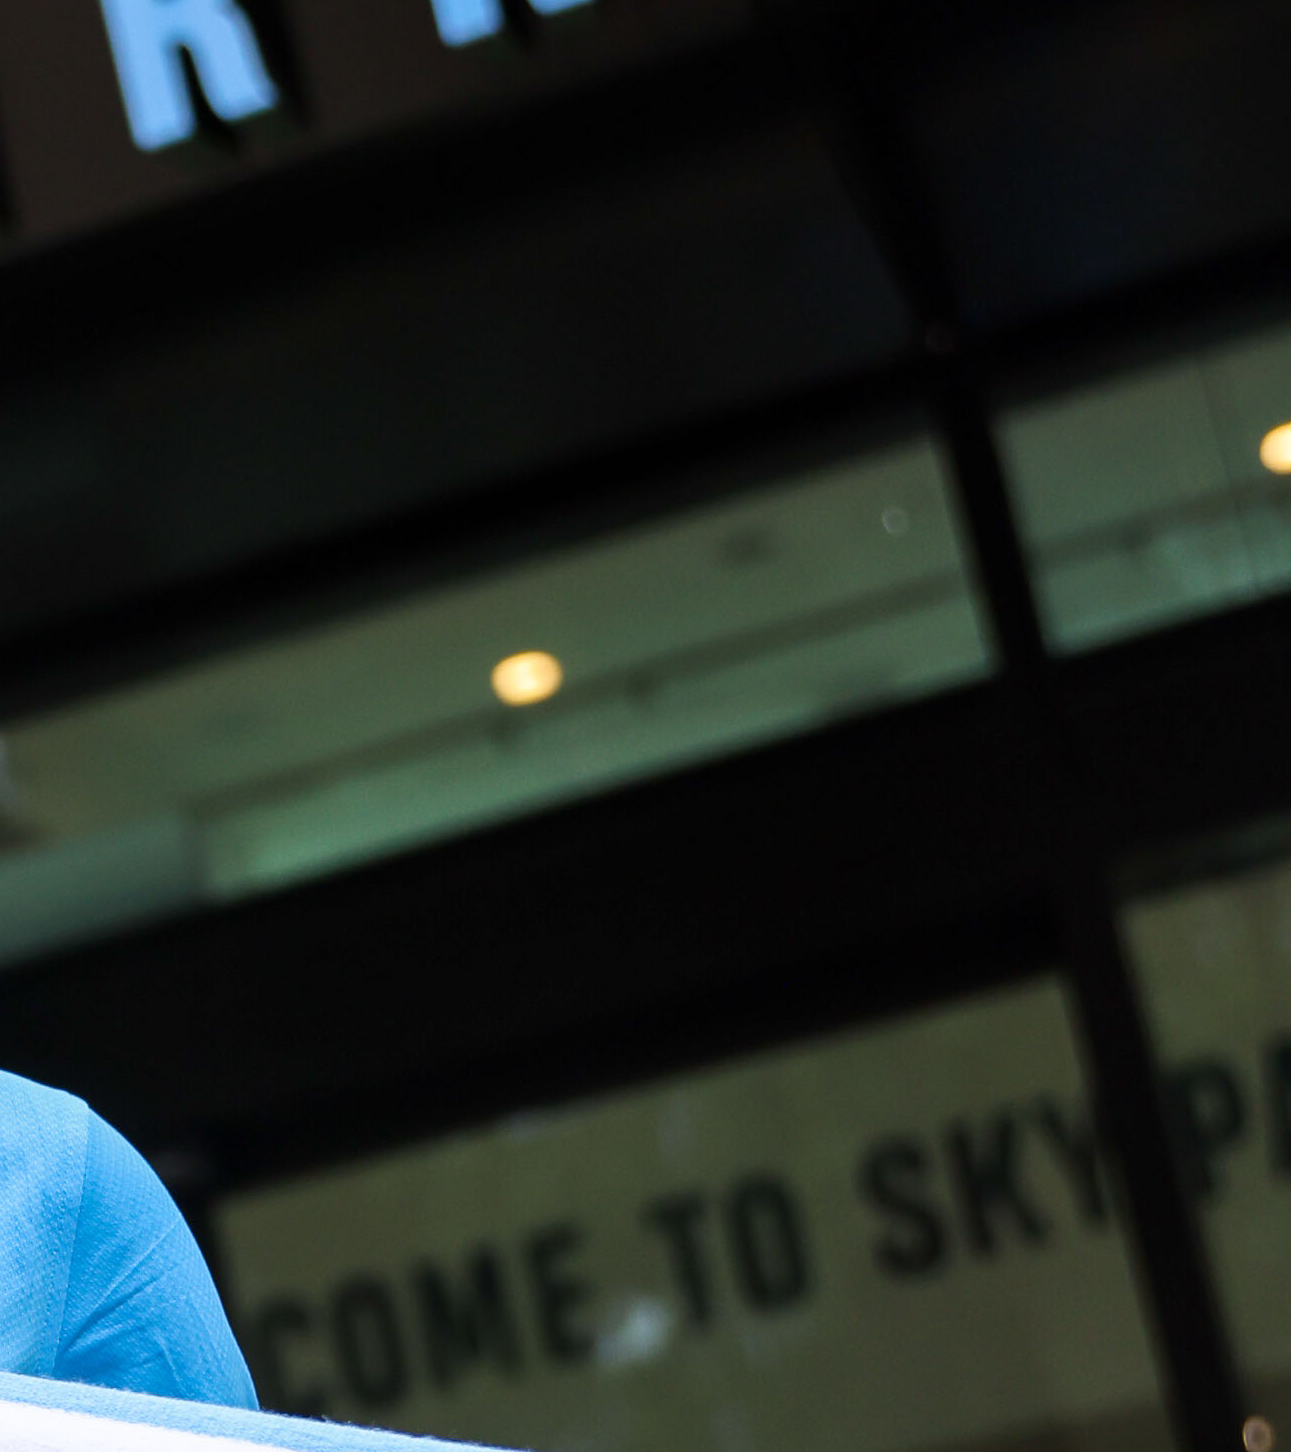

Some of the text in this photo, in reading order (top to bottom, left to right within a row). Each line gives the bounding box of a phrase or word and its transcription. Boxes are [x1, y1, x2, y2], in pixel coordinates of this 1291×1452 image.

[642, 1173, 813, 1334] TO
[859, 1093, 1107, 1278] SKY
[1157, 1035, 1291, 1208] P
